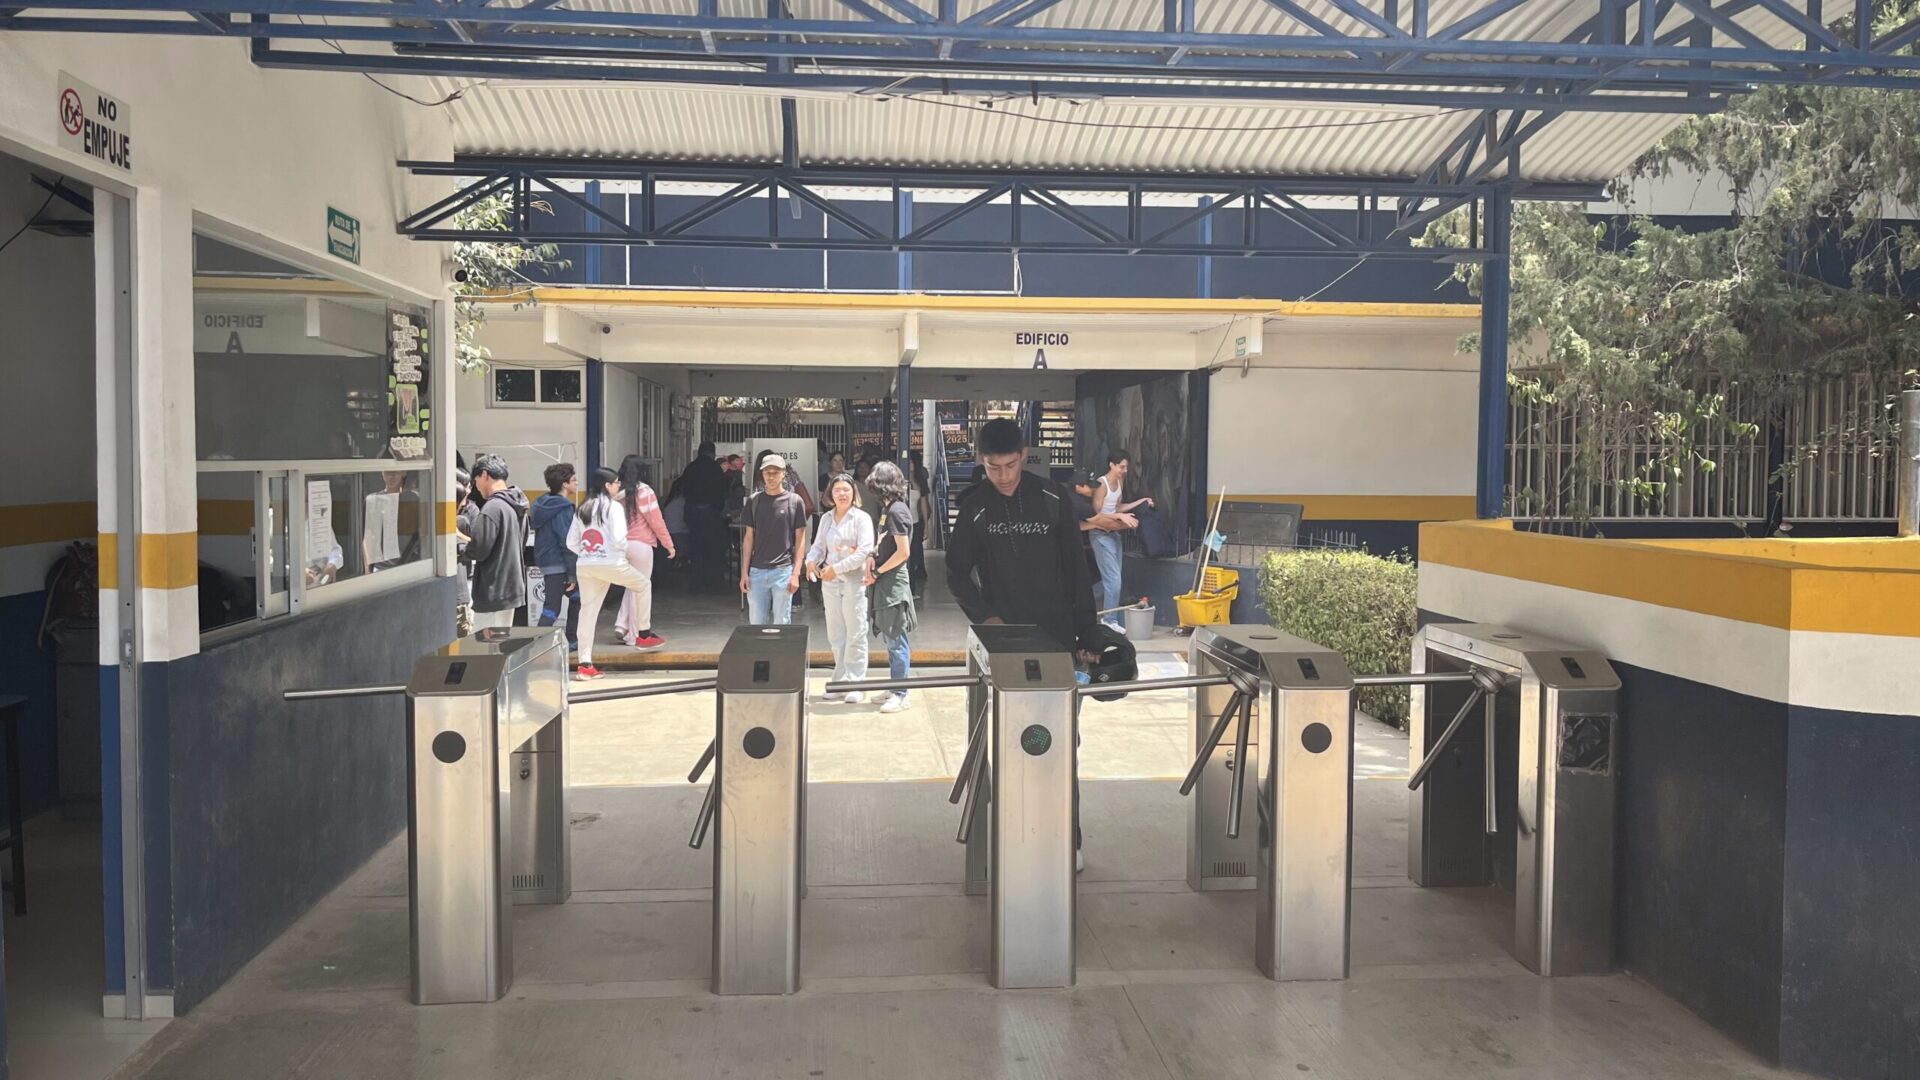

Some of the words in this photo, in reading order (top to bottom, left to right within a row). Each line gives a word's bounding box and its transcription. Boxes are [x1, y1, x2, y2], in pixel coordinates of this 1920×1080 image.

[97, 95, 117, 122] NO
[83, 117, 131, 170] EMPUJE
[1016, 333, 1069, 346] EDIFICIO
[1032, 348, 1048, 370] A
[946, 434, 968, 444] 2025
[789, 452, 798, 460] ES
